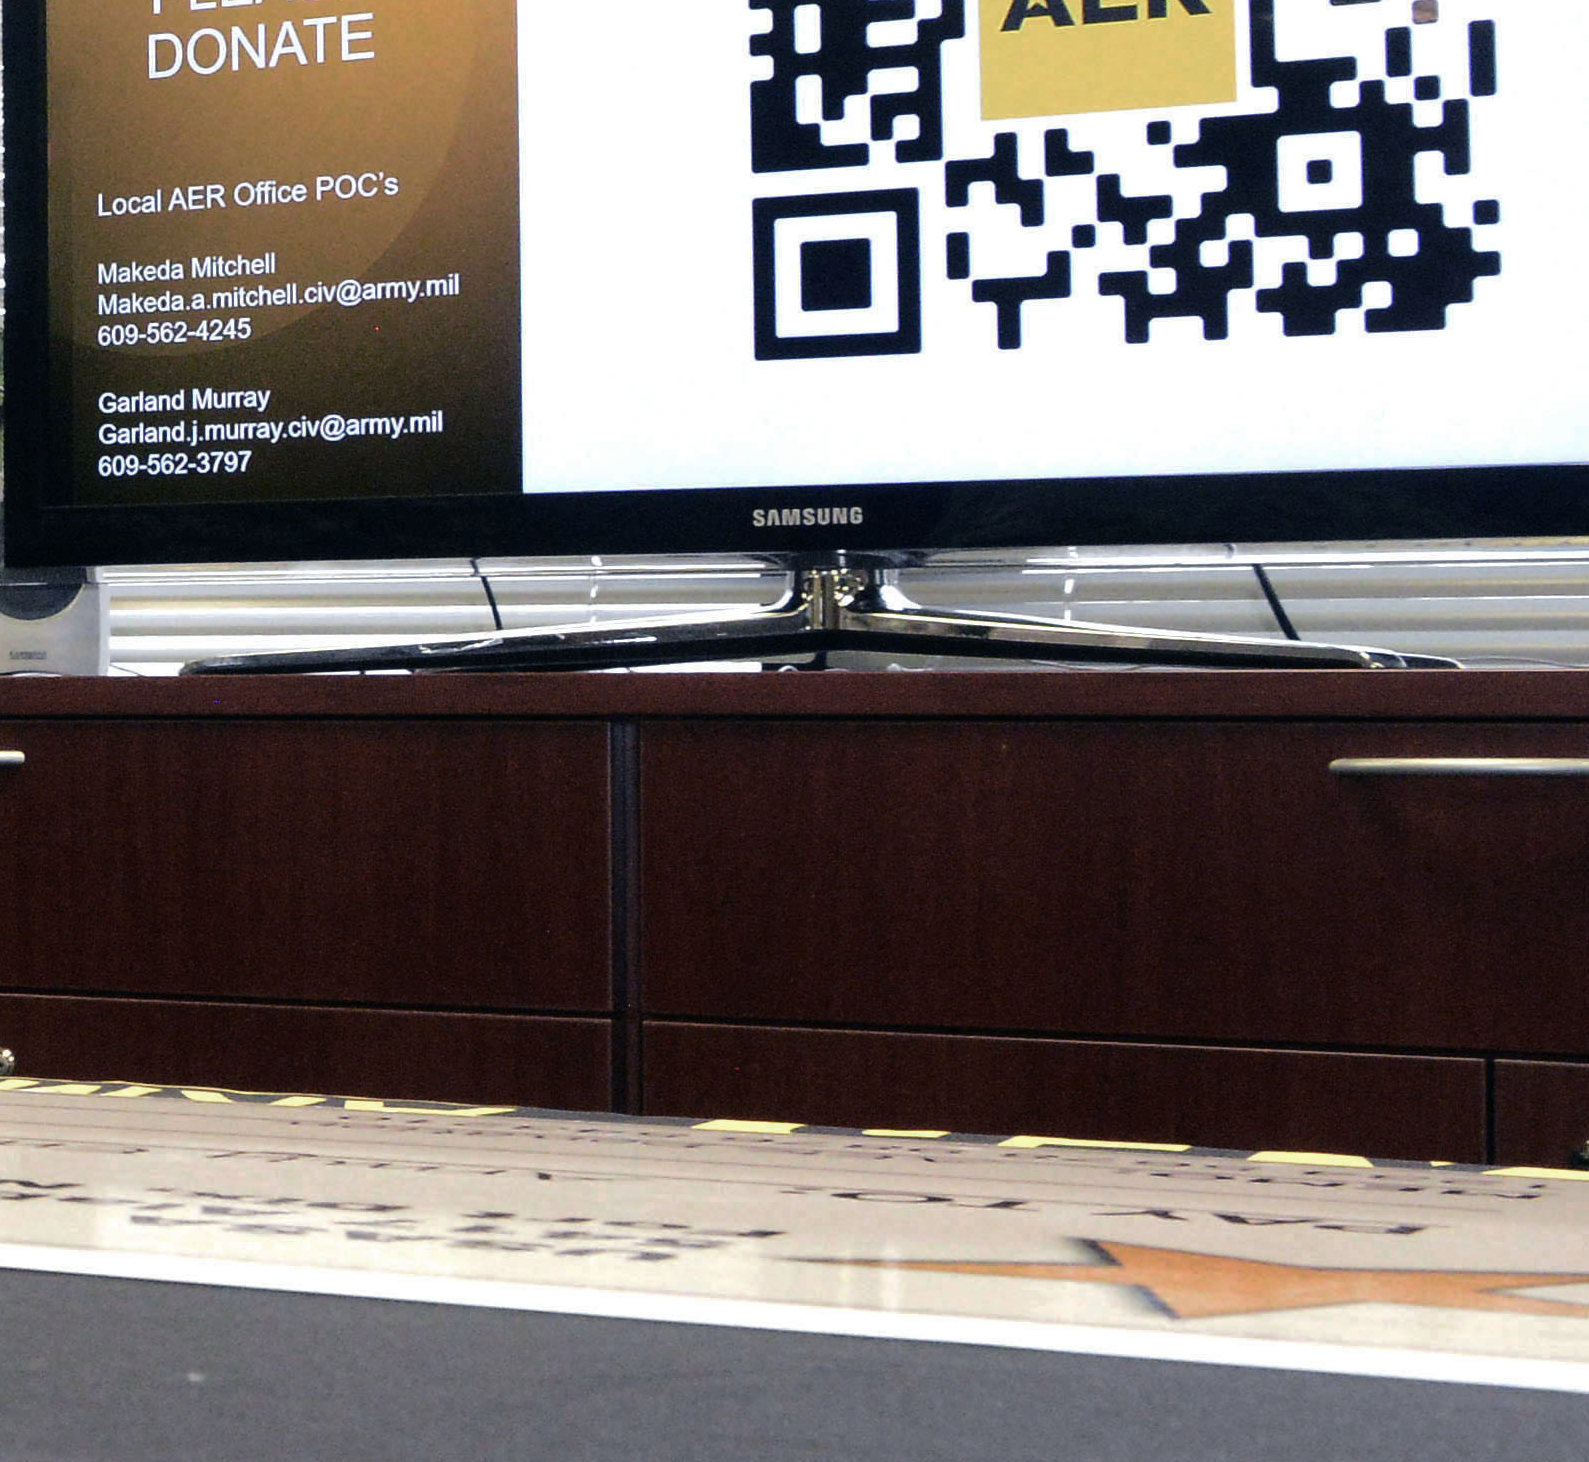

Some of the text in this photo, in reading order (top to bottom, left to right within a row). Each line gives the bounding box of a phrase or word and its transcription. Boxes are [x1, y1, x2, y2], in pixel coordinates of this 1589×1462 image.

[147, 12, 376, 80] DONATE
[97, 171, 399, 217] Local AER Office POC's
[97, 252, 276, 285] Makeda Mitchell
[97, 273, 461, 316] Makeda.a.mitchell.civ@army.mil
[97, 318, 252, 347] 609-562-4245
[97, 386, 271, 414] Garland Murray
[97, 410, 444, 445] Garland.j.murray.civ@army.mil
[97, 451, 252, 477] 609-562-3797
[752, 506, 864, 528] SAMSUNG
